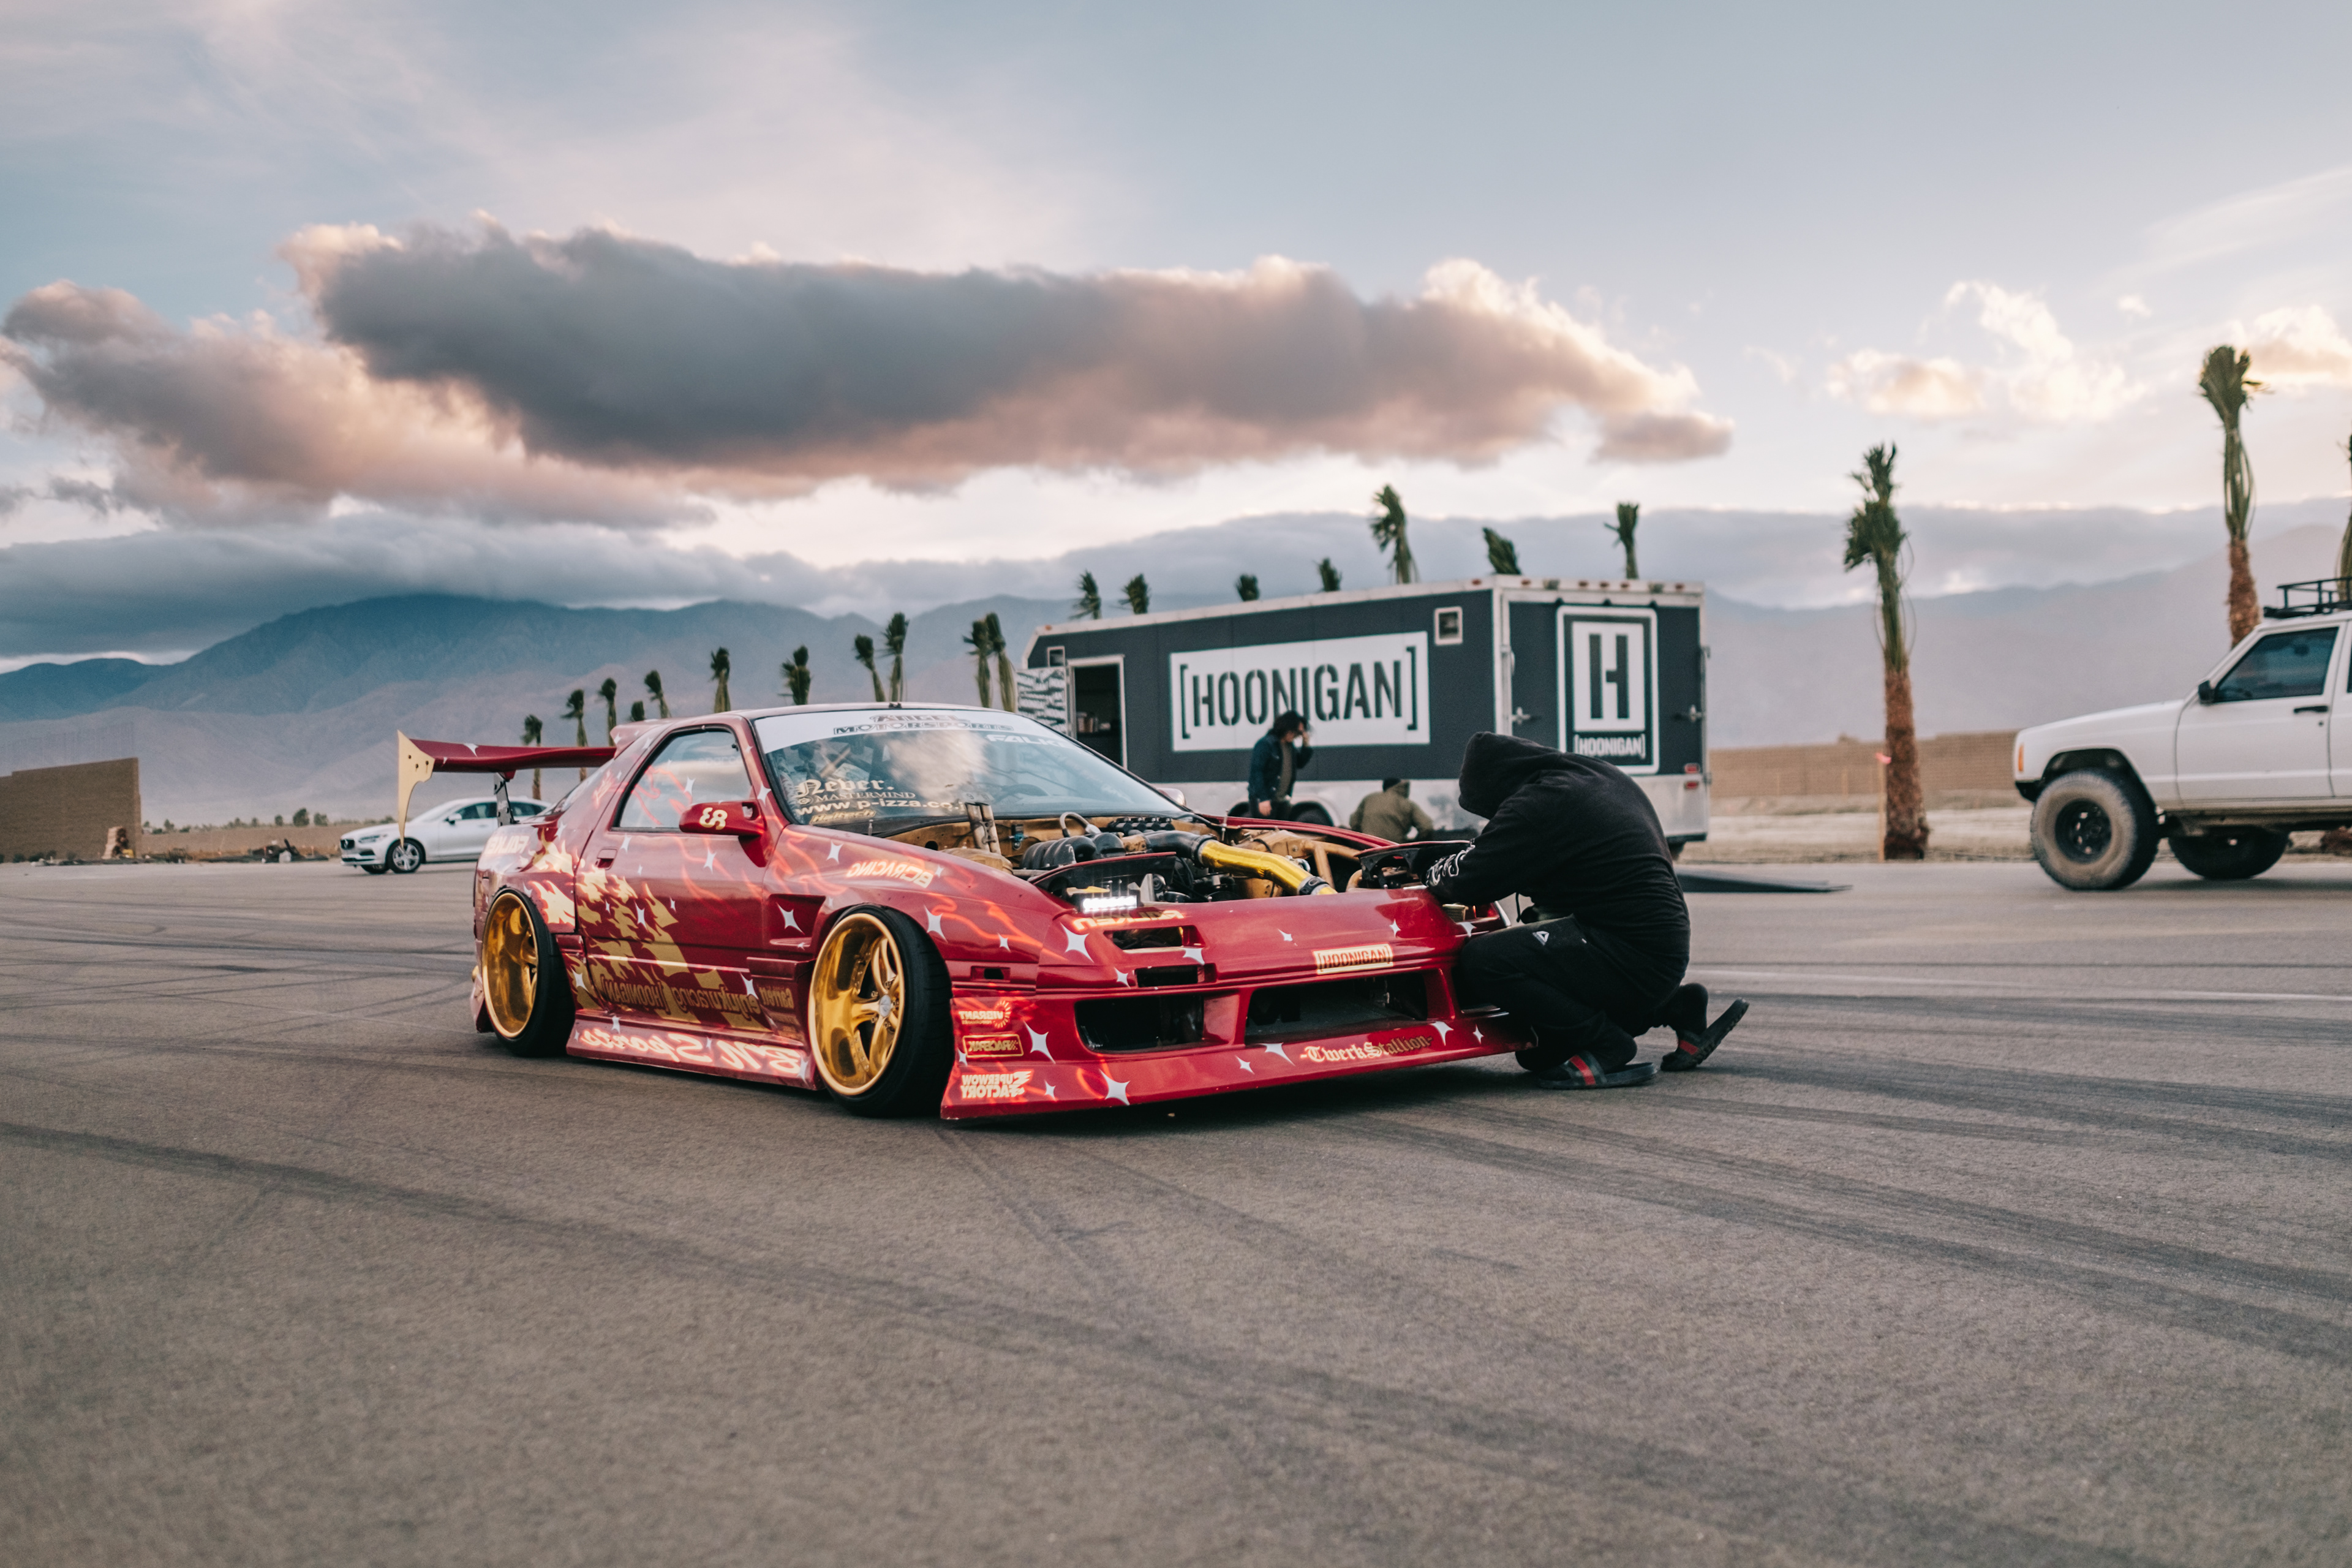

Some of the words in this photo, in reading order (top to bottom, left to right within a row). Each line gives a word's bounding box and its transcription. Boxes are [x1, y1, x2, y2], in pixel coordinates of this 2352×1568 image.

[1589, 633, 1629, 720] H
[833, 722, 1015, 735] MOTORSPORTS
[986, 734, 1063, 747] FALK
[816, 791, 916, 802] MASTERMIND
[858, 798, 966, 812] p-izza.co.j
